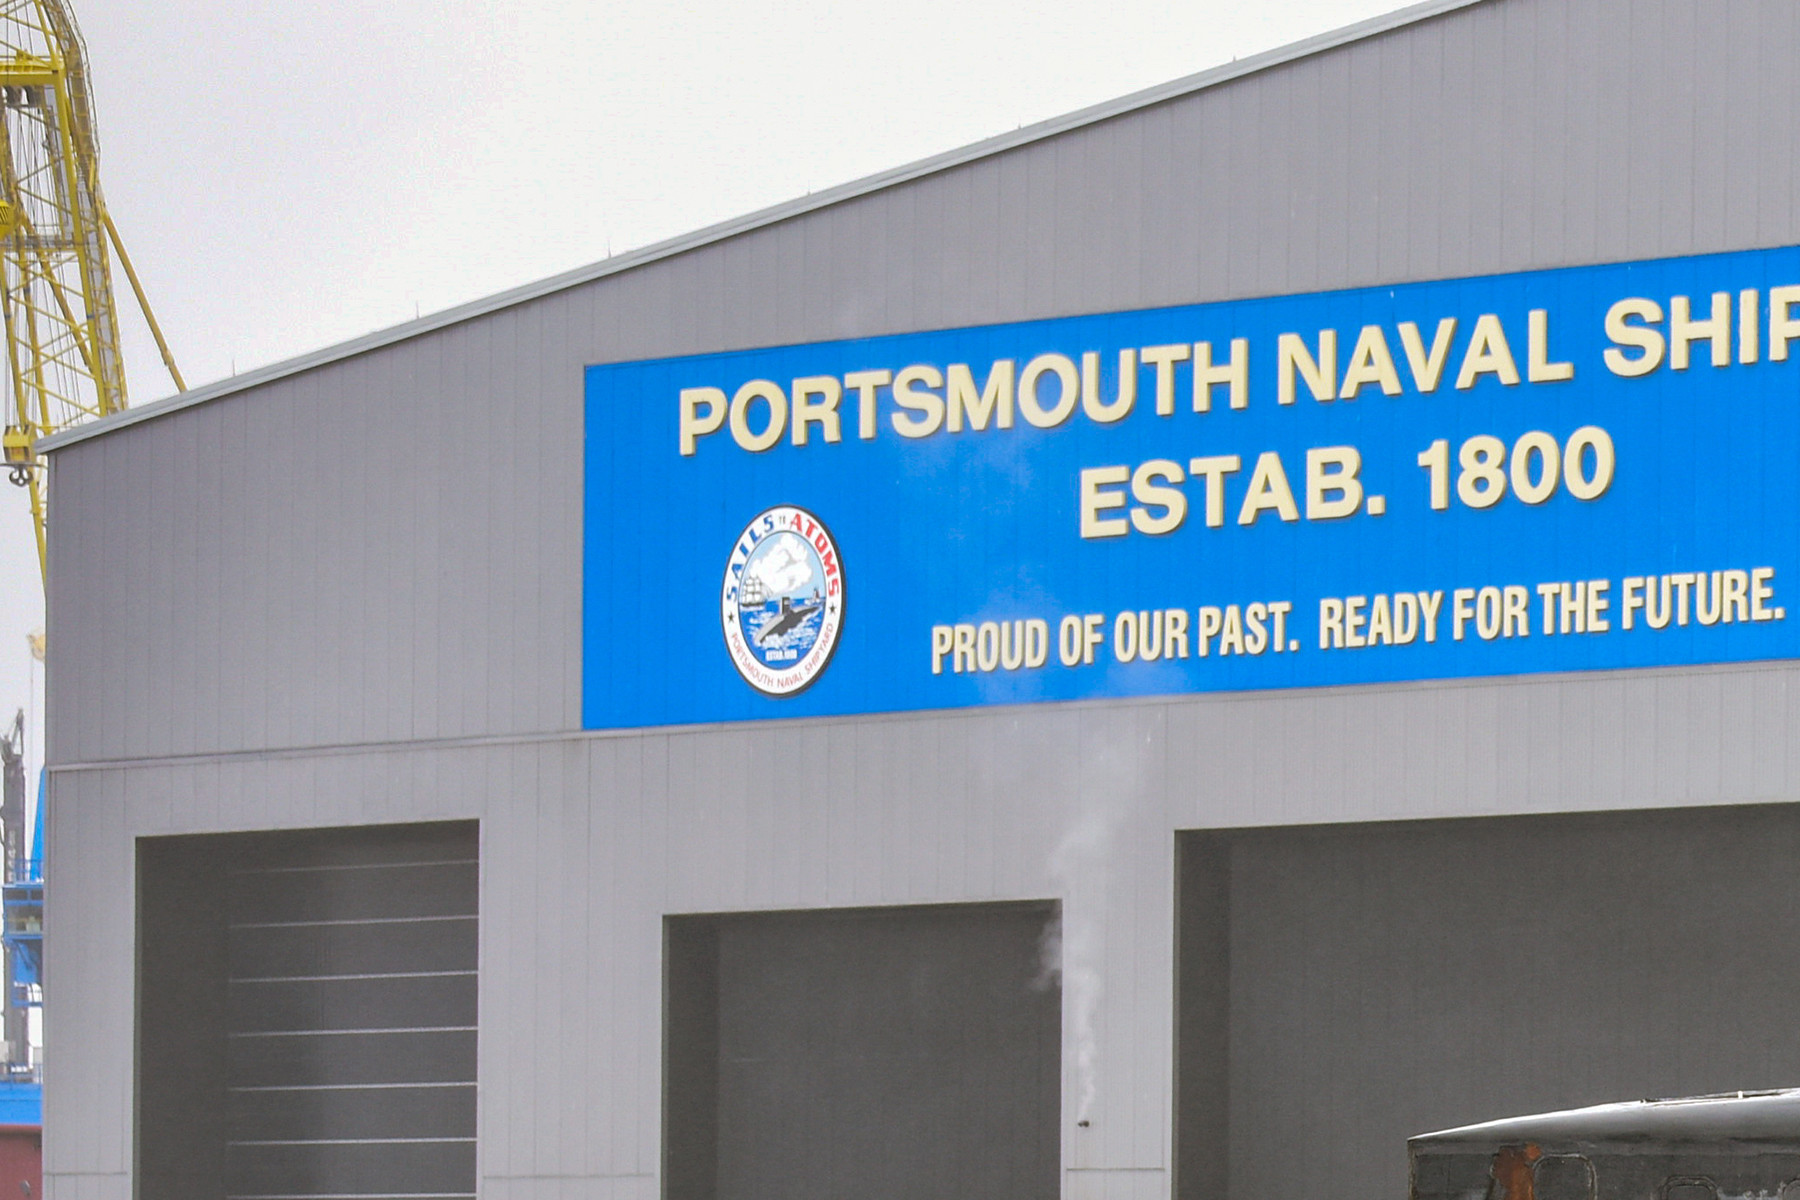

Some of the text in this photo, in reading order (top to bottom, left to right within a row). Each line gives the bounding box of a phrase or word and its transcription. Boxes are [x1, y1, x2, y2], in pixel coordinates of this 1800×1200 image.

[679, 338, 1248, 456] PORTSMOUTH
[1277, 308, 1574, 405] NAVAL
[1080, 425, 1615, 538] ESTAB. 1800
[726, 515, 774, 602] SAILS
[790, 513, 840, 598] ATOMS
[731, 623, 835, 688] PORTSMOUTH NAVAL SHIPYARD
[931, 566, 1786, 674] PROUD OF OUR PAST. READY FOR THE FUTURE.
